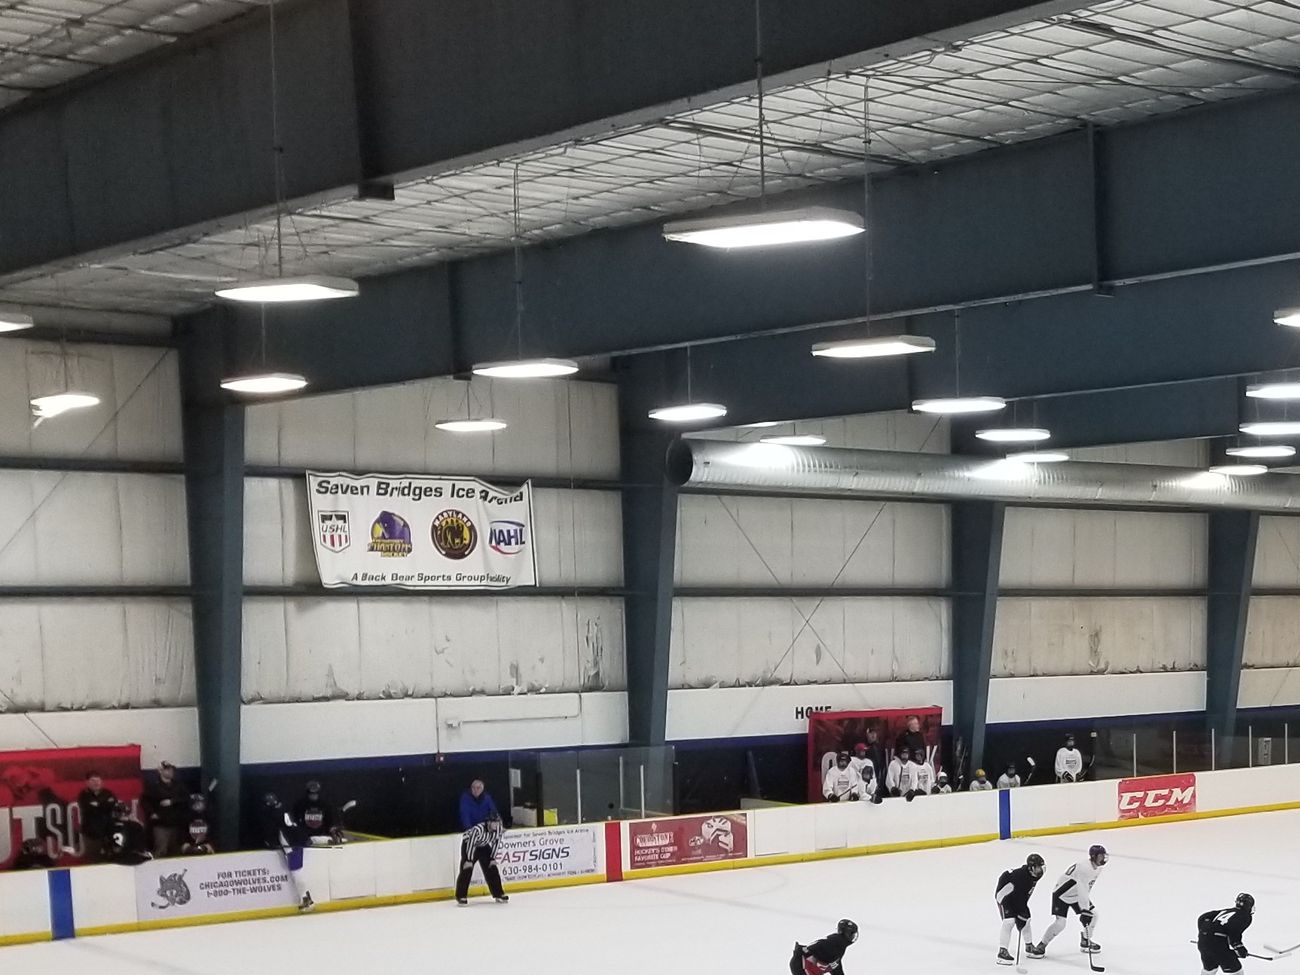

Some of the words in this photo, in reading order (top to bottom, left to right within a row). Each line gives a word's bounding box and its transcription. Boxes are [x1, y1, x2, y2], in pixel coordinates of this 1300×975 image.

[316, 480, 370, 495] Seven
[376, 481, 443, 501] Bridges
[451, 483, 475, 498] Ice
[322, 524, 347, 533] USHL
[489, 527, 525, 546] NAHL
[351, 573, 358, 581] A
[417, 573, 451, 583] Sports
[455, 573, 486, 583] Group
[1120, 787, 1194, 810] CCM
[498, 839, 536, 849] Downers
[539, 837, 564, 846] Grove
[217, 871, 233, 880] FOR
[234, 868, 270, 878] TICKETS:
[502, 863, 563, 876] 630-984-0101
[199, 875, 289, 891] CHICAGOWOLVES.COM
[206, 884, 282, 898] 1-800-THE-WOLVES
[1212, 910, 1236, 926] 14
